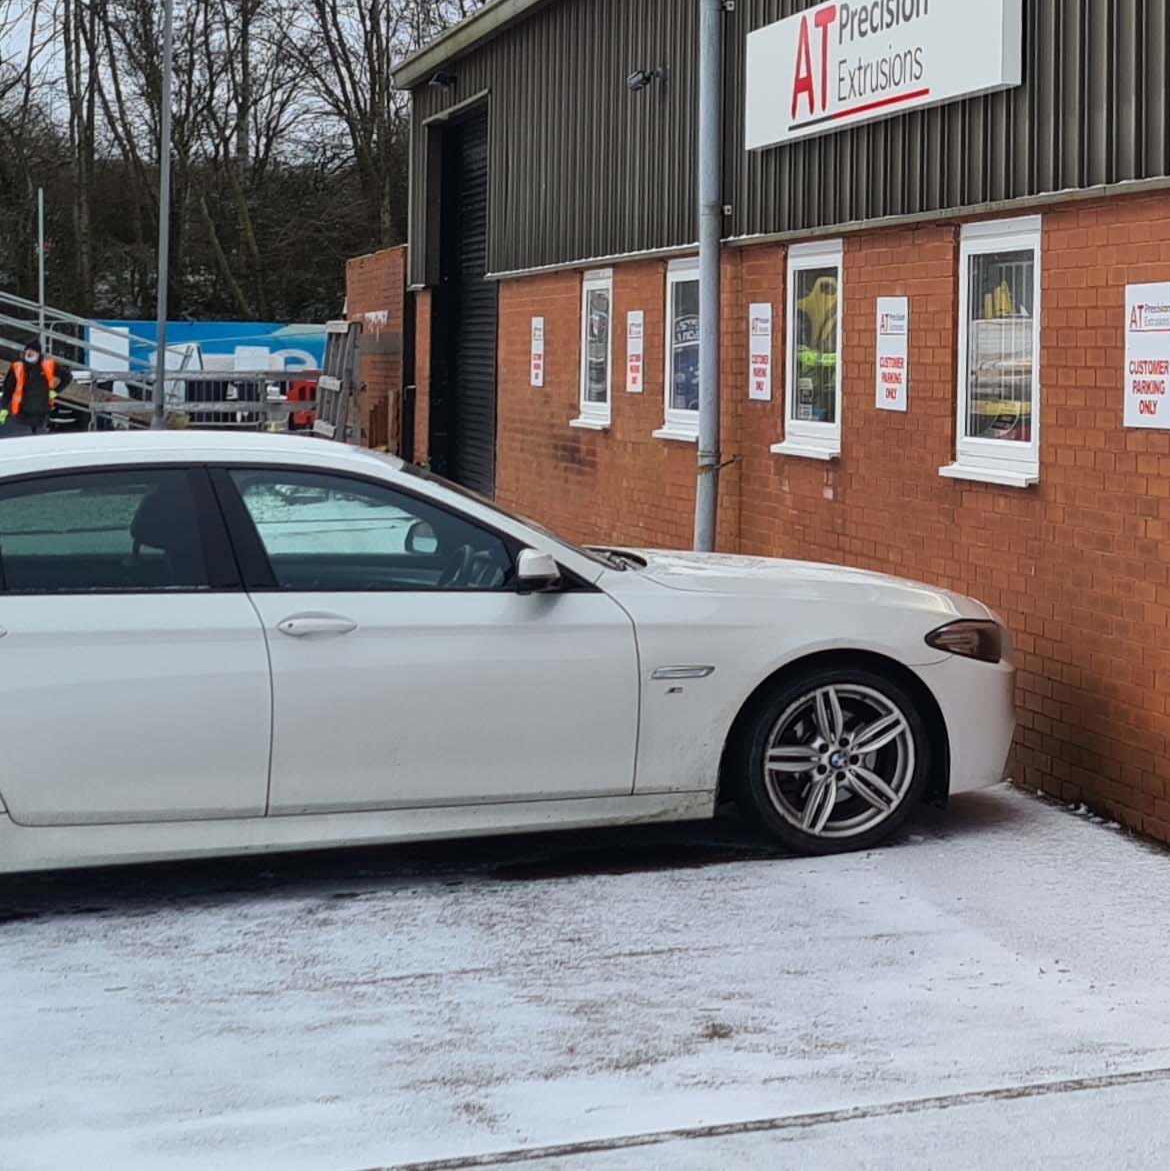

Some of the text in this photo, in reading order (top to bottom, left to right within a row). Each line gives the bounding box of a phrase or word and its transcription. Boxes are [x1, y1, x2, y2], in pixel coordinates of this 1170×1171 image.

[791, 4, 836, 120] AT
[837, 44, 924, 102] Extrusions
[1129, 304, 1145, 329] AT
[1128, 360, 1170, 375] CUSTOMER
[1132, 380, 1165, 395] PARKING
[1138, 399, 1158, 415] ONLY
